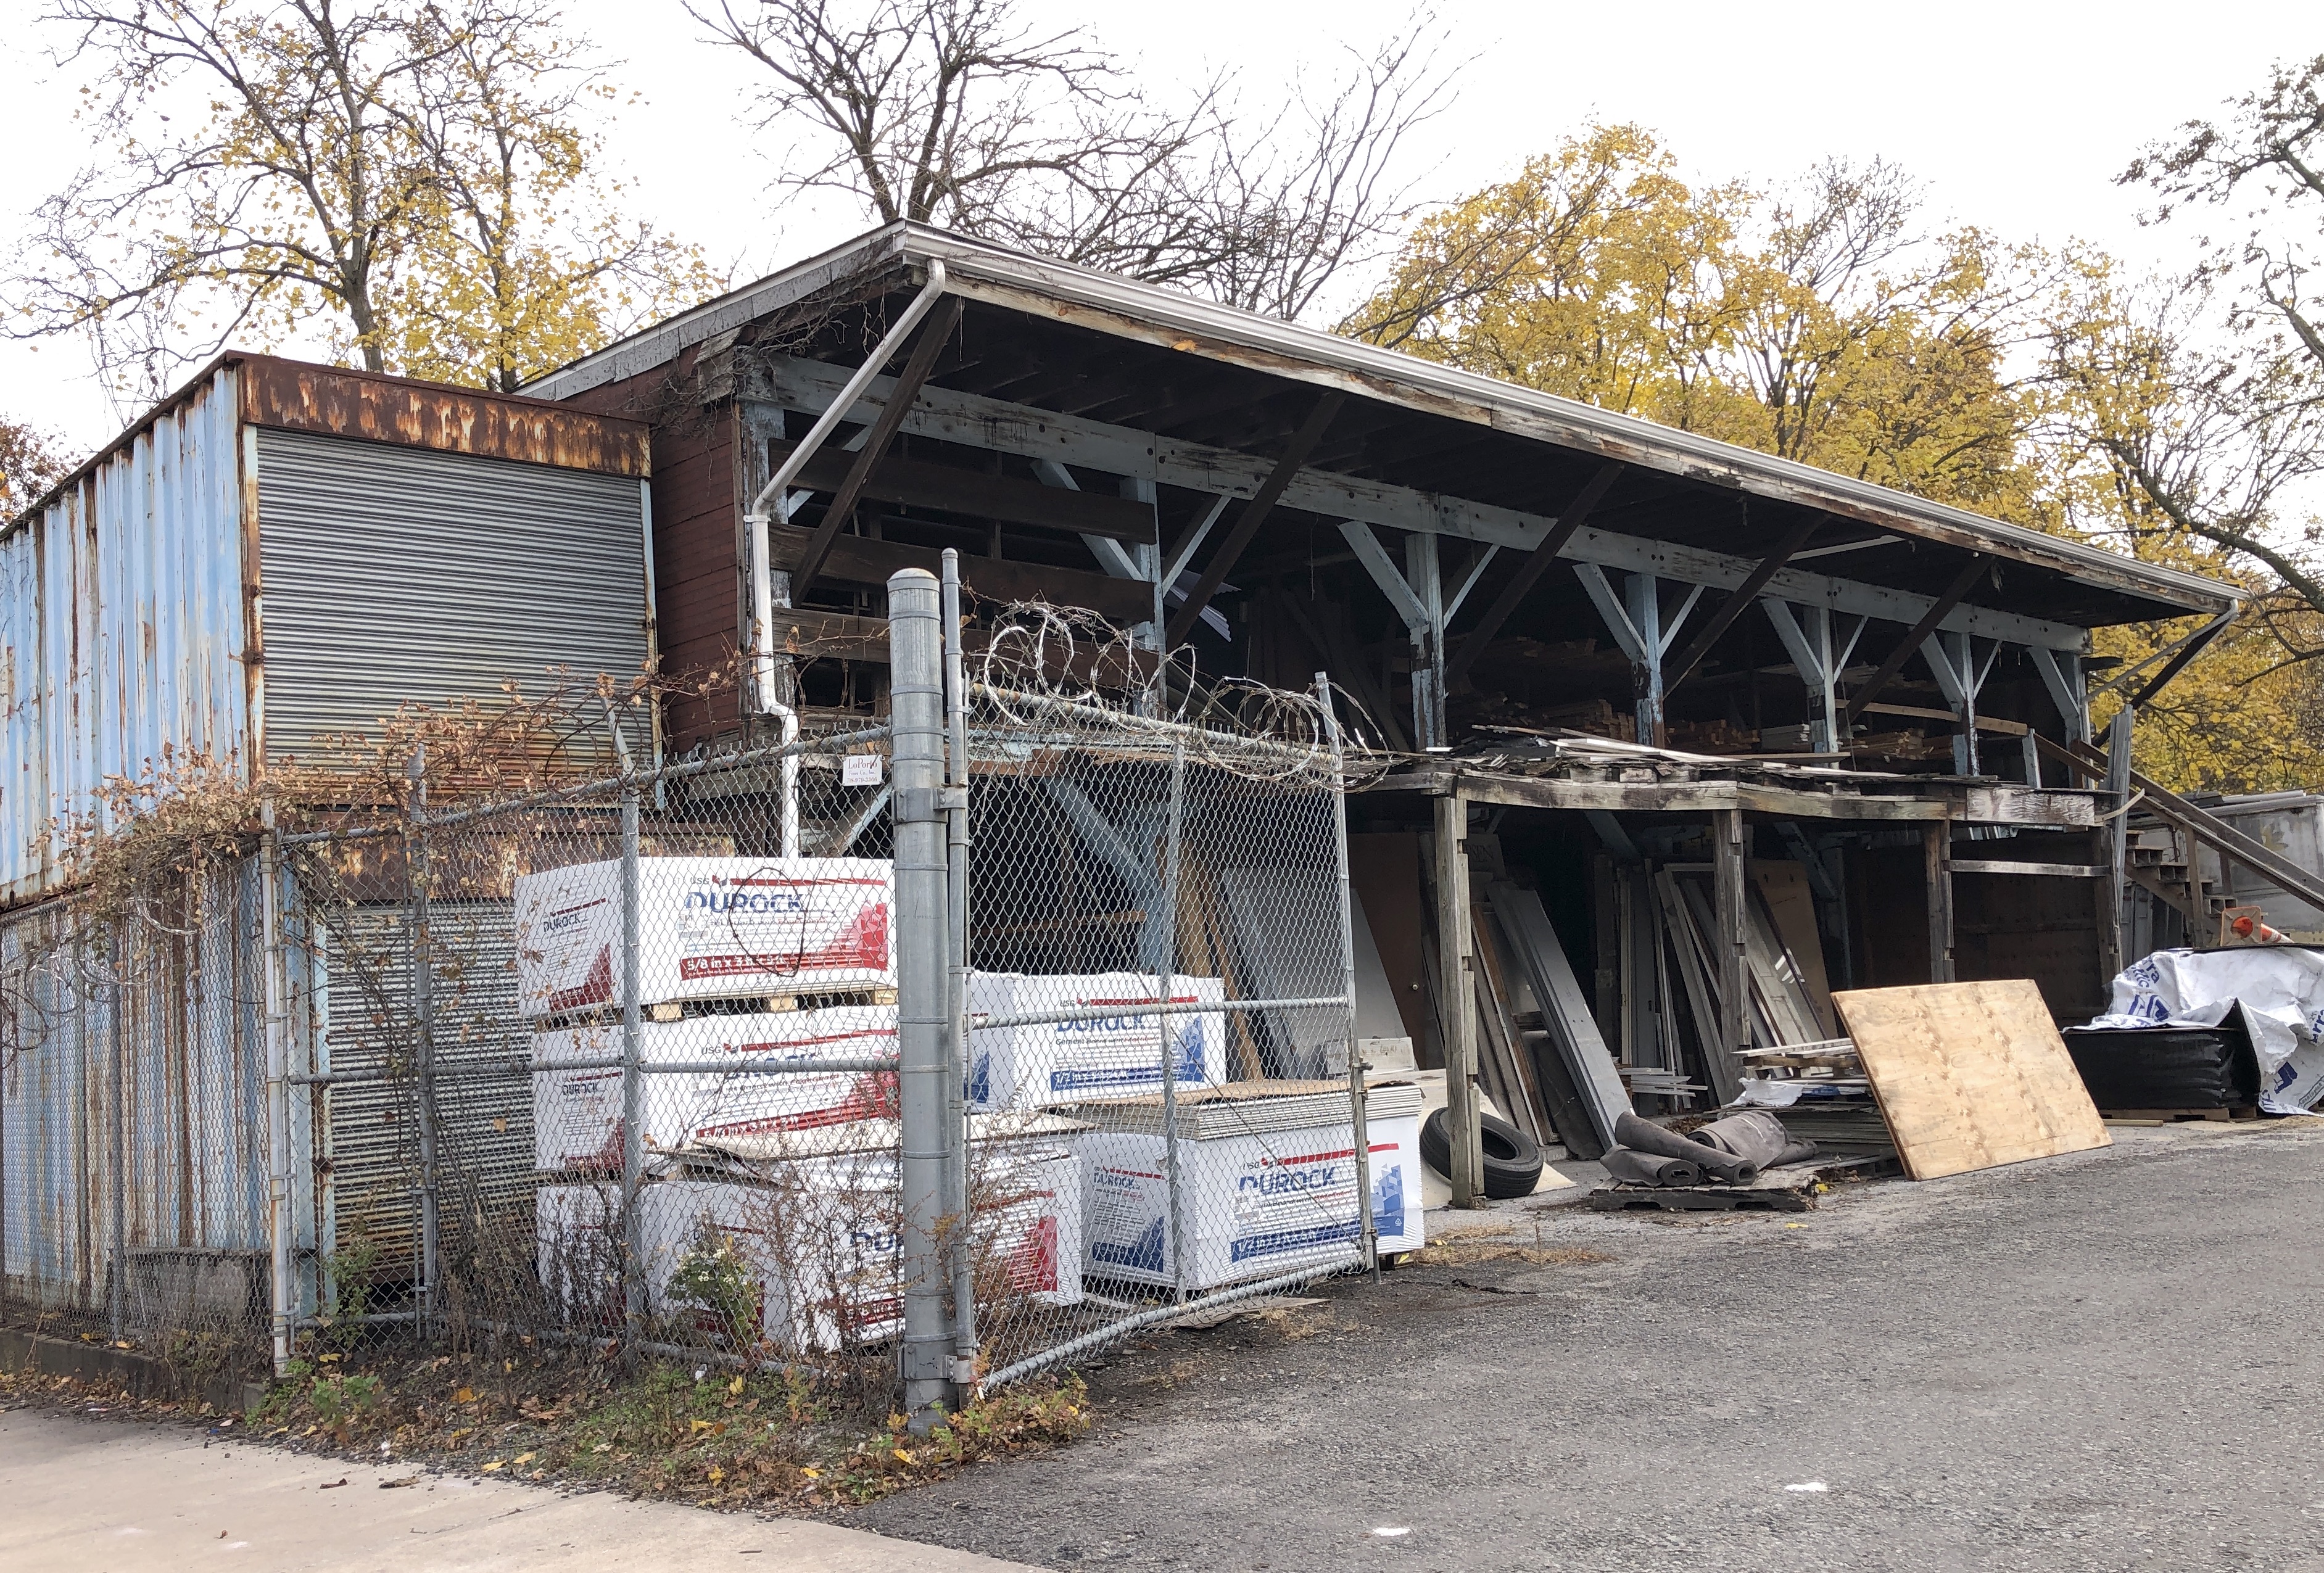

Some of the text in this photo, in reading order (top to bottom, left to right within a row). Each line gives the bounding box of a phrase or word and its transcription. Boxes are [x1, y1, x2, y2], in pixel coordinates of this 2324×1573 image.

[848, 758, 877, 769] LoPorto
[689, 877, 709, 885] USG
[684, 891, 804, 913] DUROCK
[544, 912, 581, 932] DUROCK
[687, 957, 708, 972] 5/8
[711, 957, 722, 968] in
[701, 1046, 721, 1054] USG
[1056, 1073, 1070, 1084] 1/2
[563, 1082, 598, 1096] DUROCK
[1094, 1172, 1135, 1189] DUROCK
[1239, 1166, 1340, 1195] DUROCK
